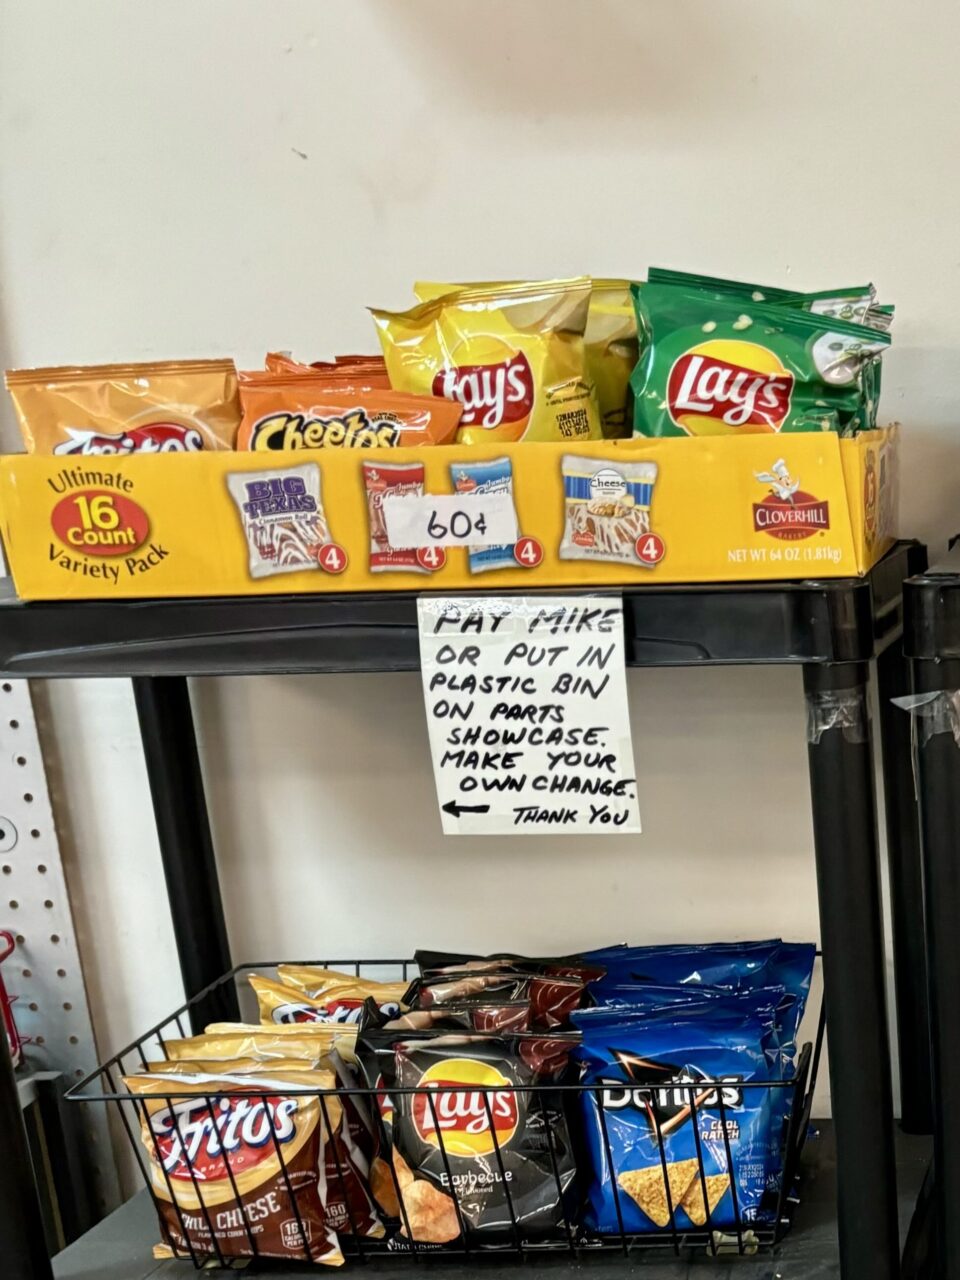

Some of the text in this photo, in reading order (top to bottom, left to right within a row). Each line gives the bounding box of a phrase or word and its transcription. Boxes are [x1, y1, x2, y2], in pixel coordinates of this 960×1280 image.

[674, 356, 787, 425] Lay's
[251, 409, 399, 450] Cheetos
[47, 466, 134, 494] Ultimate
[245, 476, 307, 501] BIG
[590, 478, 626, 489] Cheese
[73, 495, 119, 531] 16
[243, 494, 318, 519] TEXAS
[755, 507, 827, 527] CLOVERHILL
[67, 526, 136, 547] Count
[427, 510, 488, 540] 60¢
[325, 547, 341, 570] 4
[423, 546, 439, 566] 4
[520, 541, 537, 564] 4
[642, 537, 658, 560] 4
[728, 547, 842, 563] NET WT 64 OZ (1.81kg)
[48, 543, 170, 585] Variety Pack
[434, 606, 623, 634] PAY MIKE
[435, 642, 616, 670] OR PUT IN
[430, 671, 610, 700] PLASTIC BIN
[432, 699, 565, 725] ON PARTS
[447, 725, 610, 748] SHOWCASE.
[440, 749, 616, 773] MAKE YOUR
[459, 773, 637, 800] OWN CHANGE.
[513, 803, 629, 826] THANK YOU
[151, 1095, 299, 1176] Fritos
